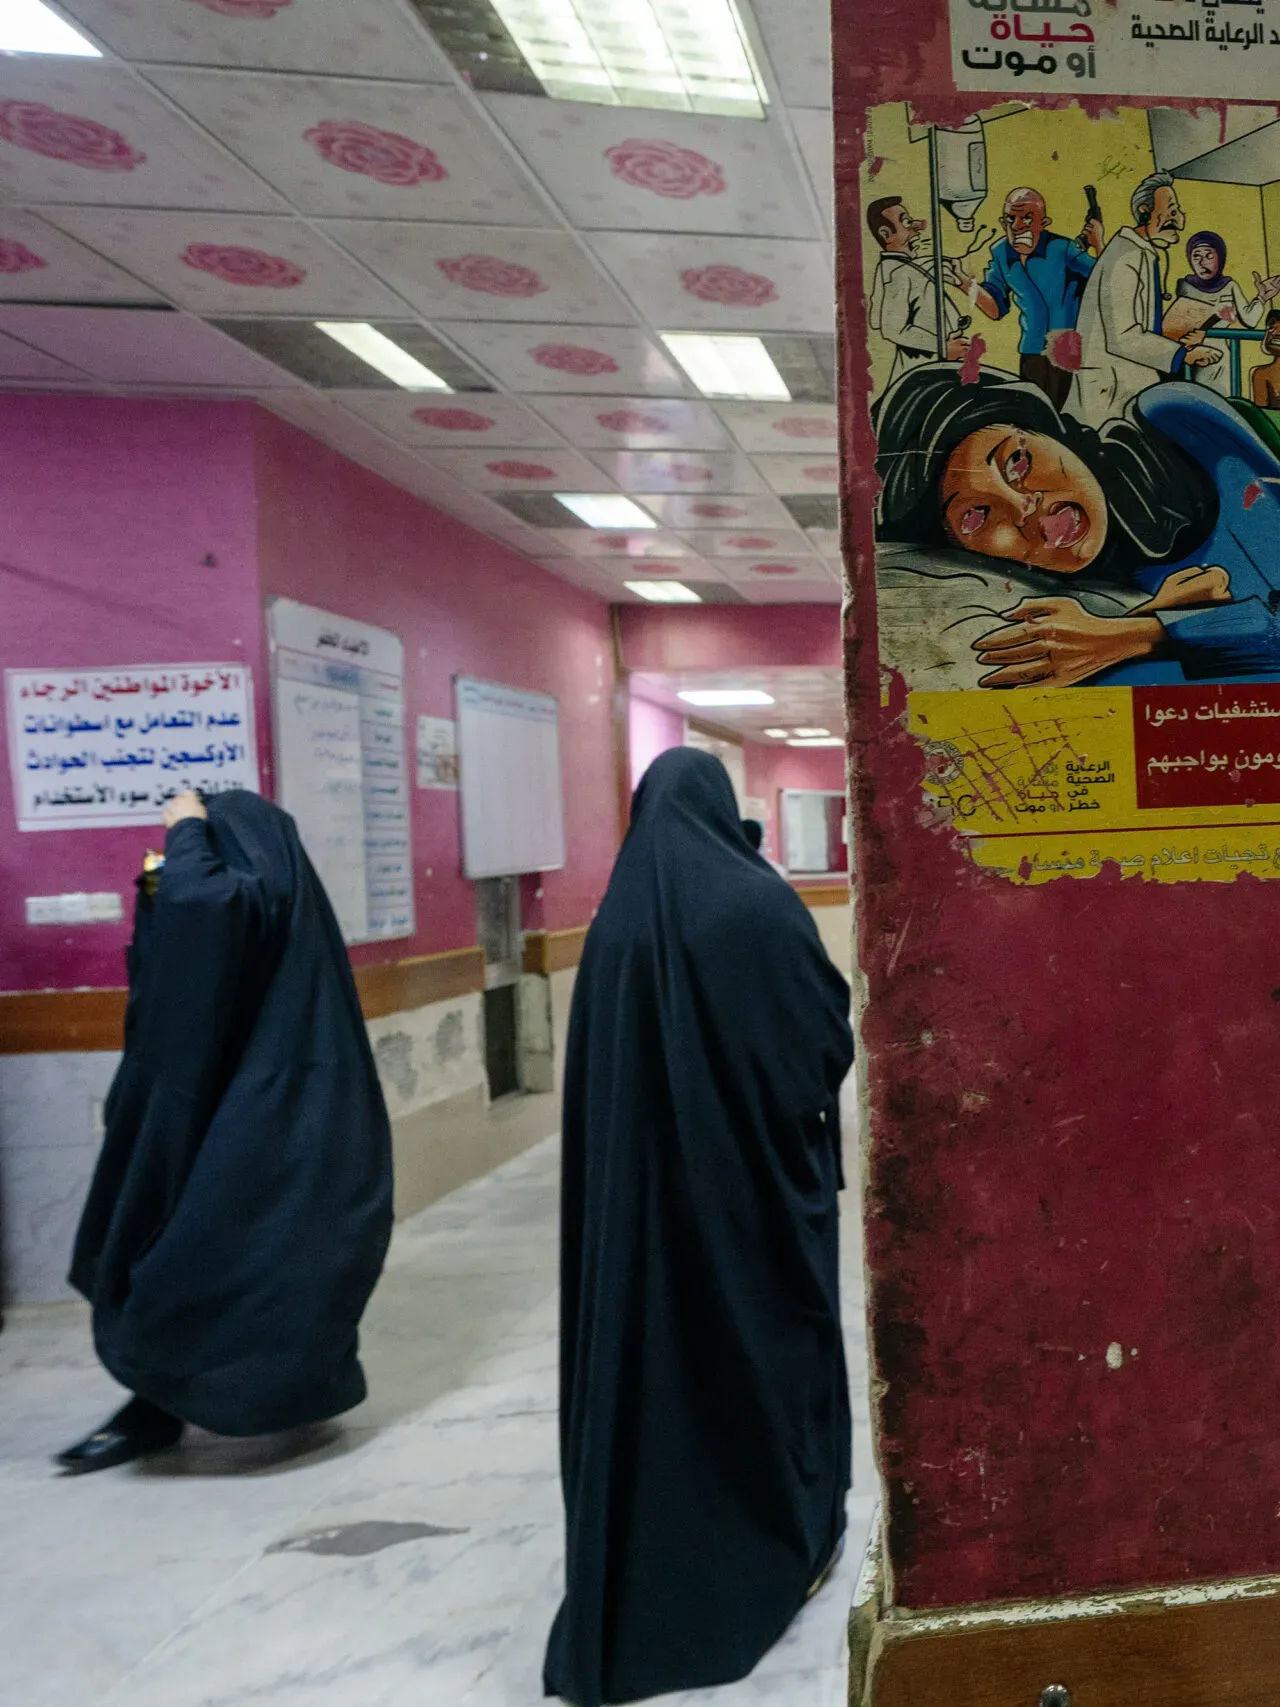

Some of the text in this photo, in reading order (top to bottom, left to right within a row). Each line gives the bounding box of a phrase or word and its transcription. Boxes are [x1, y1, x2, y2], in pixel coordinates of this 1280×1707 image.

[989, 13, 1095, 48] حياة
[1131, 14, 1199, 48] الصحية
[1205, 17, 1264, 51] الرعاية
[961, 44, 1096, 78] أو موت
[20, 678, 87, 702] الرجاء
[91, 675, 176, 702] المواطنين
[138, 709, 203, 734] التعامل
[206, 710, 240, 733] عدم
[1145, 703, 1189, 726] دعوا
[114, 716, 135, 740] مع
[25, 748, 96, 775] الحوادث
[101, 746, 155, 773] لتجنب
[1065, 760, 1111, 774] الرعاية
[1146, 748, 1230, 776] بواجبهم
[1066, 773, 1116, 787] الصحية
[118, 789, 149, 808] سوء
[1066, 785, 1090, 801] في
[1067, 799, 1101, 813] خطر
[1089, 848, 1146, 868] صة
[1150, 846, 1199, 875] اعلام
[1203, 843, 1270, 870] تحيات
